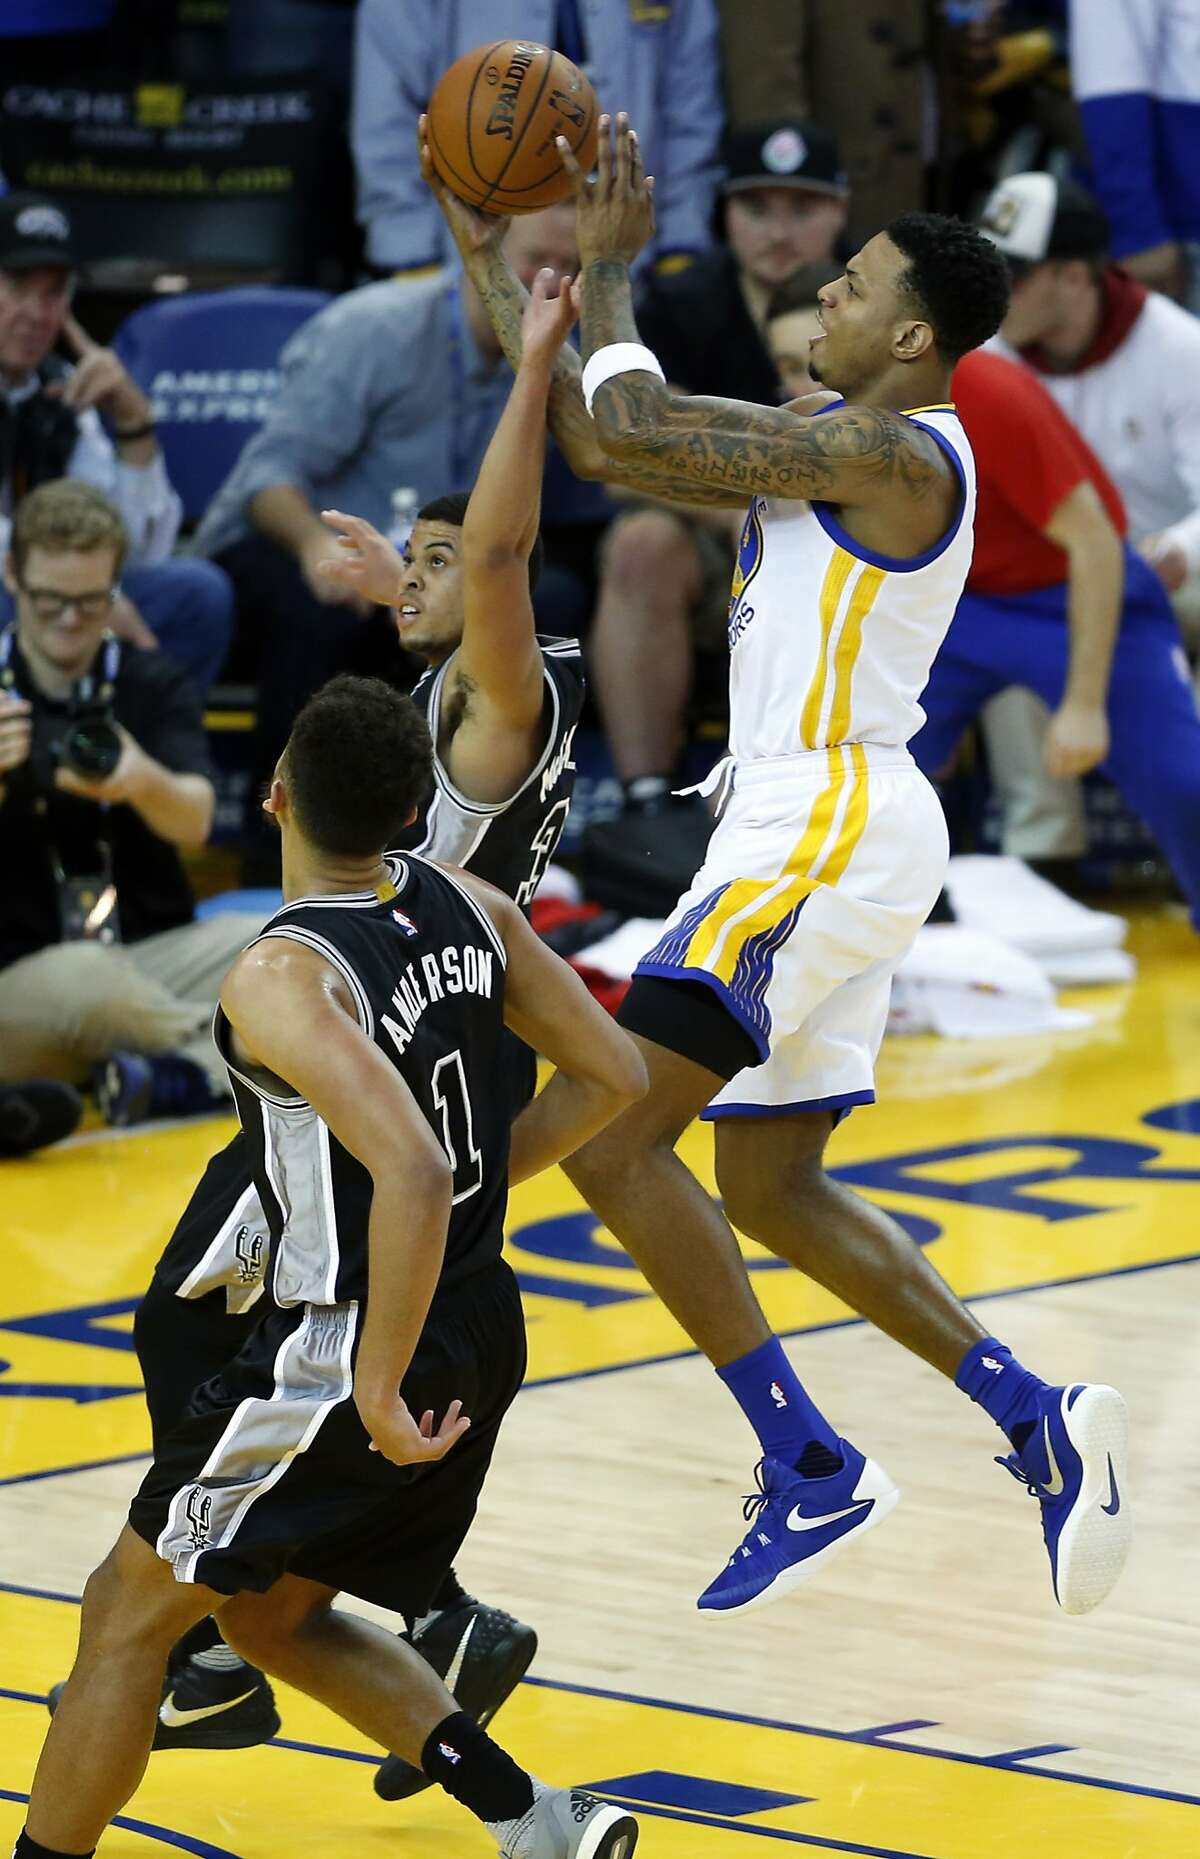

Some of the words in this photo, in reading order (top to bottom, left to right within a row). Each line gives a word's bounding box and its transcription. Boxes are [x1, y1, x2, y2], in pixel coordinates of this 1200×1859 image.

[485, 42, 545, 141] SPALDING
[380, 945, 494, 1055] ANDERSON
[430, 1049, 483, 1206] 1
